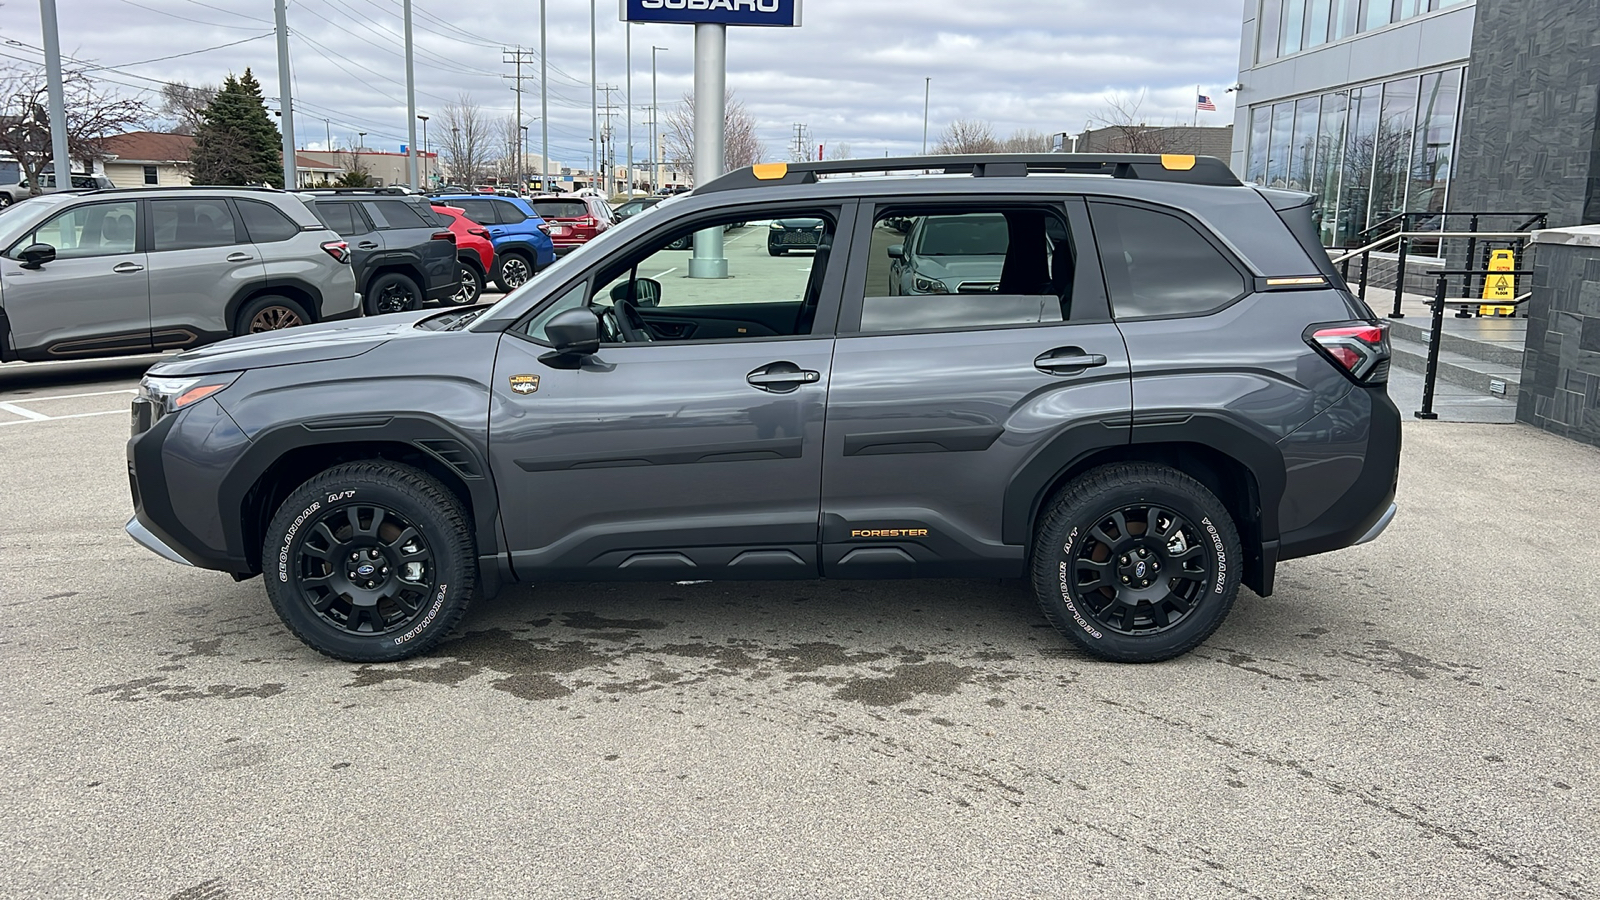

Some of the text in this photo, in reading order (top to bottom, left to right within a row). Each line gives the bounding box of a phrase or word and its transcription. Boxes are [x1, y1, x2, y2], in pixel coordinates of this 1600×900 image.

[278, 490, 356, 583] GEOLANDAR A/T
[851, 529, 928, 537] FORESTER
[1201, 517, 1226, 594] YOKOHAMA
[394, 584, 448, 646] YOKOHAMA
[1059, 527, 1103, 640] GEOLANDAR A/T
